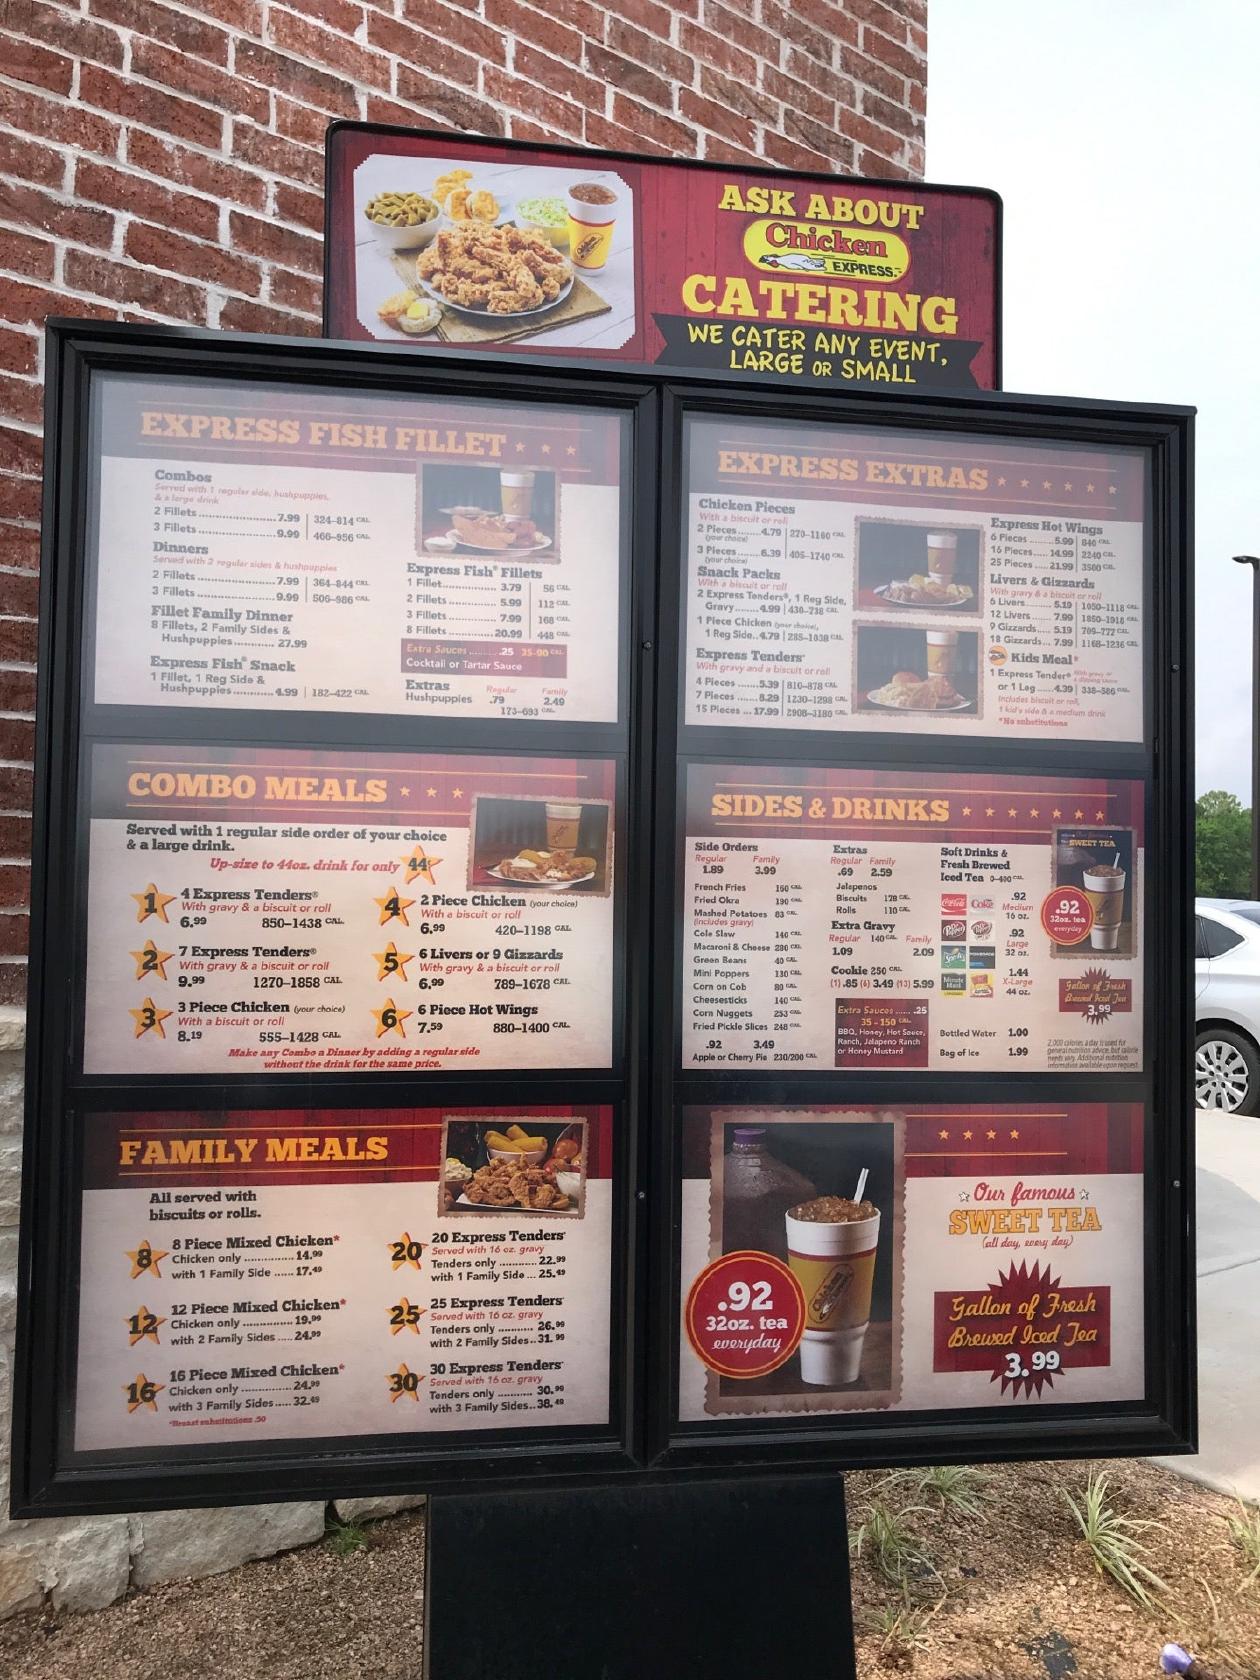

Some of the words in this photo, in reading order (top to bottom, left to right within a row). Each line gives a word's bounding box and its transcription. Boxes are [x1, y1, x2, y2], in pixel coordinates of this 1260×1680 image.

[719, 184, 799, 216] ASK
[806, 194, 924, 230] ABOUT
[765, 222, 888, 259] Chicken
[681, 274, 959, 334] CATERING
[688, 324, 723, 344] WE
[732, 328, 806, 352] CATER
[814, 334, 860, 356] ANY
[868, 339, 949, 367] EVENT,
[730, 349, 803, 374] LARGE
[812, 360, 833, 377] OR
[840, 359, 916, 383] SMALL
[140, 412, 300, 445] EXPRESS
[309, 422, 387, 449] FISH
[396, 427, 507, 456] FILLET
[155, 469, 212, 483] Combos
[718, 450, 859, 481] EXPRESS
[865, 460, 989, 491] EXTRAS
[699, 499, 753, 512] Chicken
[755, 502, 795, 514] Pieces
[154, 507, 160, 515] 2
[164, 507, 197, 518] Fillets
[277, 514, 300, 523] 7.99
[990, 518, 1039, 532] Express
[1042, 520, 1064, 532] Hot
[1066, 522, 1103, 535] Wings
[152, 542, 209, 554] Dinners
[697, 567, 739, 578] Snack
[742, 569, 780, 580] Packs
[990, 574, 1027, 586] Livers
[1031, 576, 1039, 586] &
[1042, 576, 1094, 589] Gizzards
[151, 606, 189, 618] Fillet
[192, 607, 242, 622] Family
[246, 610, 293, 622] Dinner
[162, 634, 233, 647] Hushpuppies
[277, 639, 308, 648] 27.99
[406, 659, 445, 669] Cocktail
[449, 661, 459, 669] or
[463, 660, 491, 670] Tartar
[494, 662, 522, 671] Sauce
[405, 680, 450, 691] Extras
[128, 773, 256, 799] COMBO
[264, 776, 387, 803] MEALS
[712, 794, 803, 817] SIDES
[808, 800, 826, 817] &
[832, 797, 950, 822] DRINKS
[126, 823, 177, 836] Served
[180, 825, 212, 836] with
[216, 826, 222, 836] 1
[227, 827, 277, 839] regular
[281, 828, 309, 838] side
[313, 829, 349, 839] order
[353, 829, 366, 840] of
[370, 831, 400, 842] your
[404, 830, 447, 841] choice
[126, 840, 136, 849] &
[140, 841, 148, 849] a
[152, 840, 188, 851] large
[193, 839, 235, 851] drink.
[695, 843, 719, 851] Side
[722, 843, 758, 852] Orders
[941, 848, 962, 857] Soft
[965, 848, 998, 858] Drinks
[1001, 849, 1008, 857] &
[702, 865, 724, 874] 1.89
[755, 866, 776, 875] 3.99
[941, 860, 969, 869] Fresh
[973, 861, 1010, 870] Brewed
[941, 873, 962, 882] Iced
[965, 873, 984, 882] Tea
[181, 889, 189, 898] 4
[193, 889, 250, 901] Express
[695, 884, 723, 892] French
[726, 884, 746, 892] Fries
[144, 893, 157, 913] 1
[182, 902, 206, 912] With
[210, 903, 238, 913] gravy
[242, 903, 249, 911] &
[263, 903, 296, 913] biscuit
[300, 905, 308, 913] or
[314, 904, 331, 913] roll
[1056, 900, 1080, 914] .92
[180, 917, 206, 928] 6.99
[832, 921, 861, 930] Extra
[864, 921, 895, 933] Gravy
[694, 956, 719, 964] Green
[722, 956, 747, 964] Beans
[693, 996, 747, 1004] Cheesesticks
[178, 1002, 186, 1012] 3
[189, 1002, 227, 1013] Piece
[231, 1002, 290, 1013] Chicken
[294, 1005, 314, 1014] (your
[317, 1005, 345, 1013] choice)
[418, 1005, 426, 1014] 6
[430, 1005, 464, 1015] Piece
[469, 1005, 492, 1015] Hot
[497, 1005, 538, 1017] Wings
[1088, 1004, 1111, 1016] 3.99
[141, 1008, 156, 1027] 3
[381, 1008, 397, 1028] 6
[418, 1022, 443, 1033] 7.59
[940, 1029, 969, 1037] Bottled
[1008, 1028, 1028, 1037] 1.00
[178, 1031, 202, 1041] 8.19
[693, 1053, 715, 1062] Apple
[728, 1053, 753, 1063] Cherry
[755, 1054, 767, 1062] Pie
[119, 1139, 259, 1165] FAMILY
[265, 1137, 388, 1162] MEALS
[150, 1193, 171, 1203] All
[175, 1192, 221, 1203] served
[225, 1191, 256, 1201] with
[973, 1183, 1005, 1201] Our
[1010, 1183, 1075, 1206] famous
[150, 1209, 205, 1222] biscuits
[209, 1209, 224, 1219] or
[227, 1208, 261, 1219] rolls.
[949, 1209, 1042, 1235] SWEET
[1048, 1207, 1102, 1232] TEA
[982, 1235, 998, 1249] (all
[1001, 1236, 1021, 1249] day,
[1025, 1236, 1045, 1249] every
[1047, 1234, 1074, 1248] day)
[173, 1253, 214, 1264] Chicken
[218, 1253, 241, 1265] only
[296, 1251, 322, 1261] 14.99
[392, 1242, 422, 1261] 20
[432, 1272, 454, 1282] with
[466, 1272, 500, 1282] Family
[503, 1271, 524, 1280] Side
[538, 1270, 566, 1278] 25.49
[717, 1281, 773, 1311] .92
[950, 1297, 1011, 1321] Gallon
[1018, 1298, 1037, 1316] of
[1043, 1292, 1096, 1315] Fresh
[390, 1306, 420, 1324] 25
[128, 1315, 158, 1335] 12
[705, 1316, 754, 1331] 32oz.
[759, 1317, 788, 1330] tea
[949, 1324, 1014, 1348] Brewed
[1020, 1324, 1058, 1345] Iced
[1063, 1325, 1096, 1347] Tea
[711, 1334, 782, 1354] everyday
[1005, 1351, 1060, 1378] 3.99
